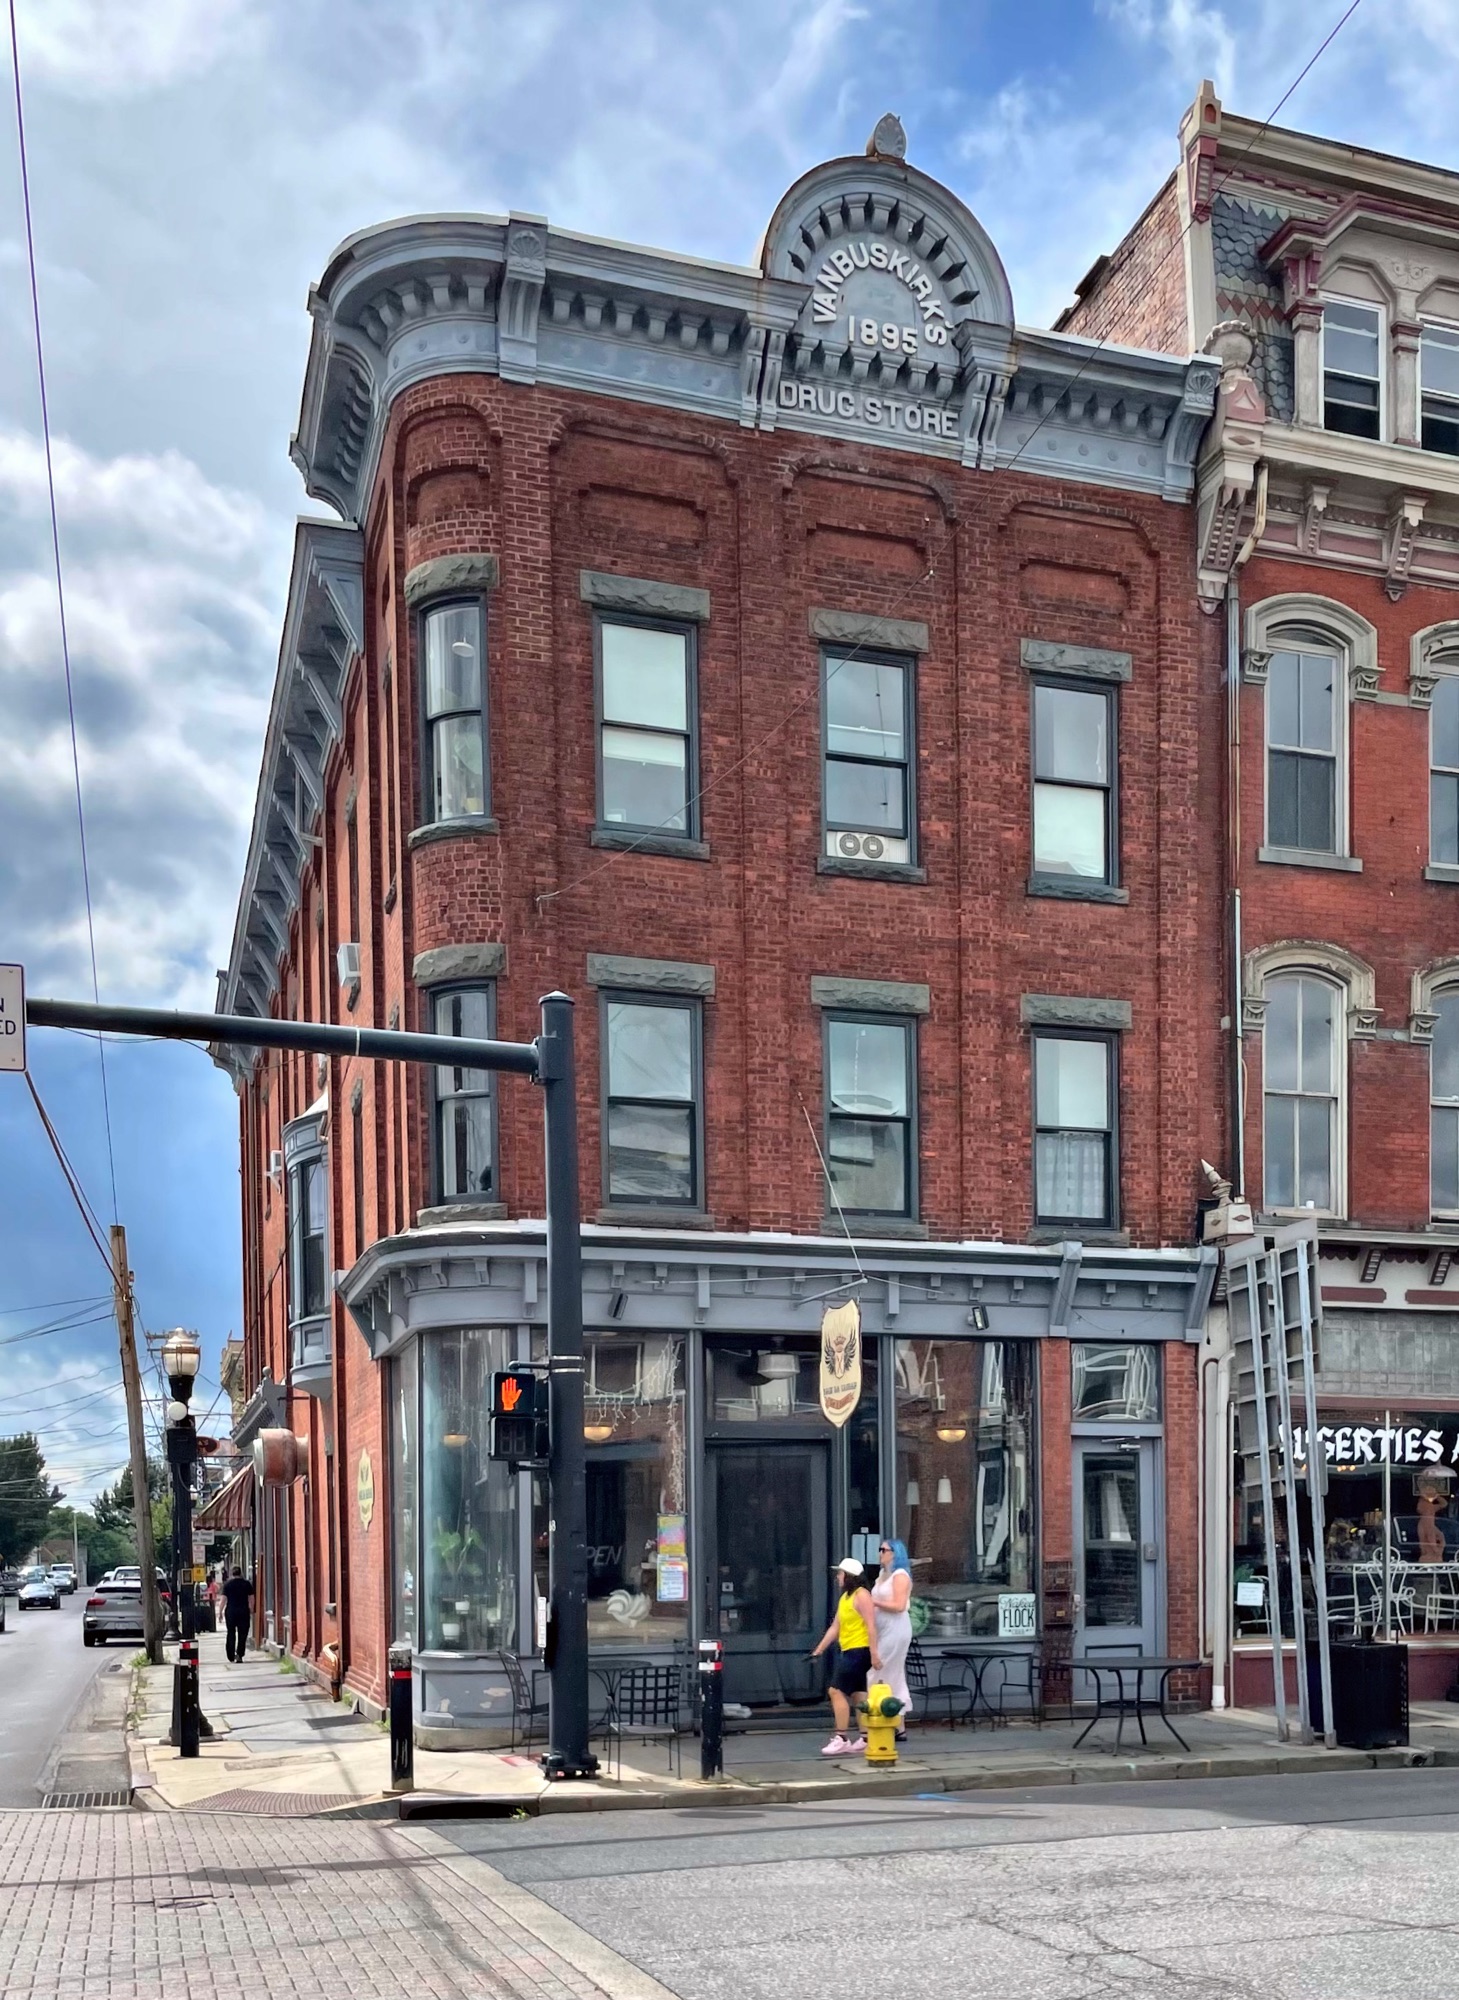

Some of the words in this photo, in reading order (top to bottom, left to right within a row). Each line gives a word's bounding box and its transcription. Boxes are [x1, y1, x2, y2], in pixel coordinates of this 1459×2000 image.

[848, 315, 918, 354] 1895
[779, 381, 855, 417] DRUG
[864, 396, 959, 438] STORE
[586, 1545, 622, 1566] PEN
[1003, 1608, 1034, 1627] FLOCK
